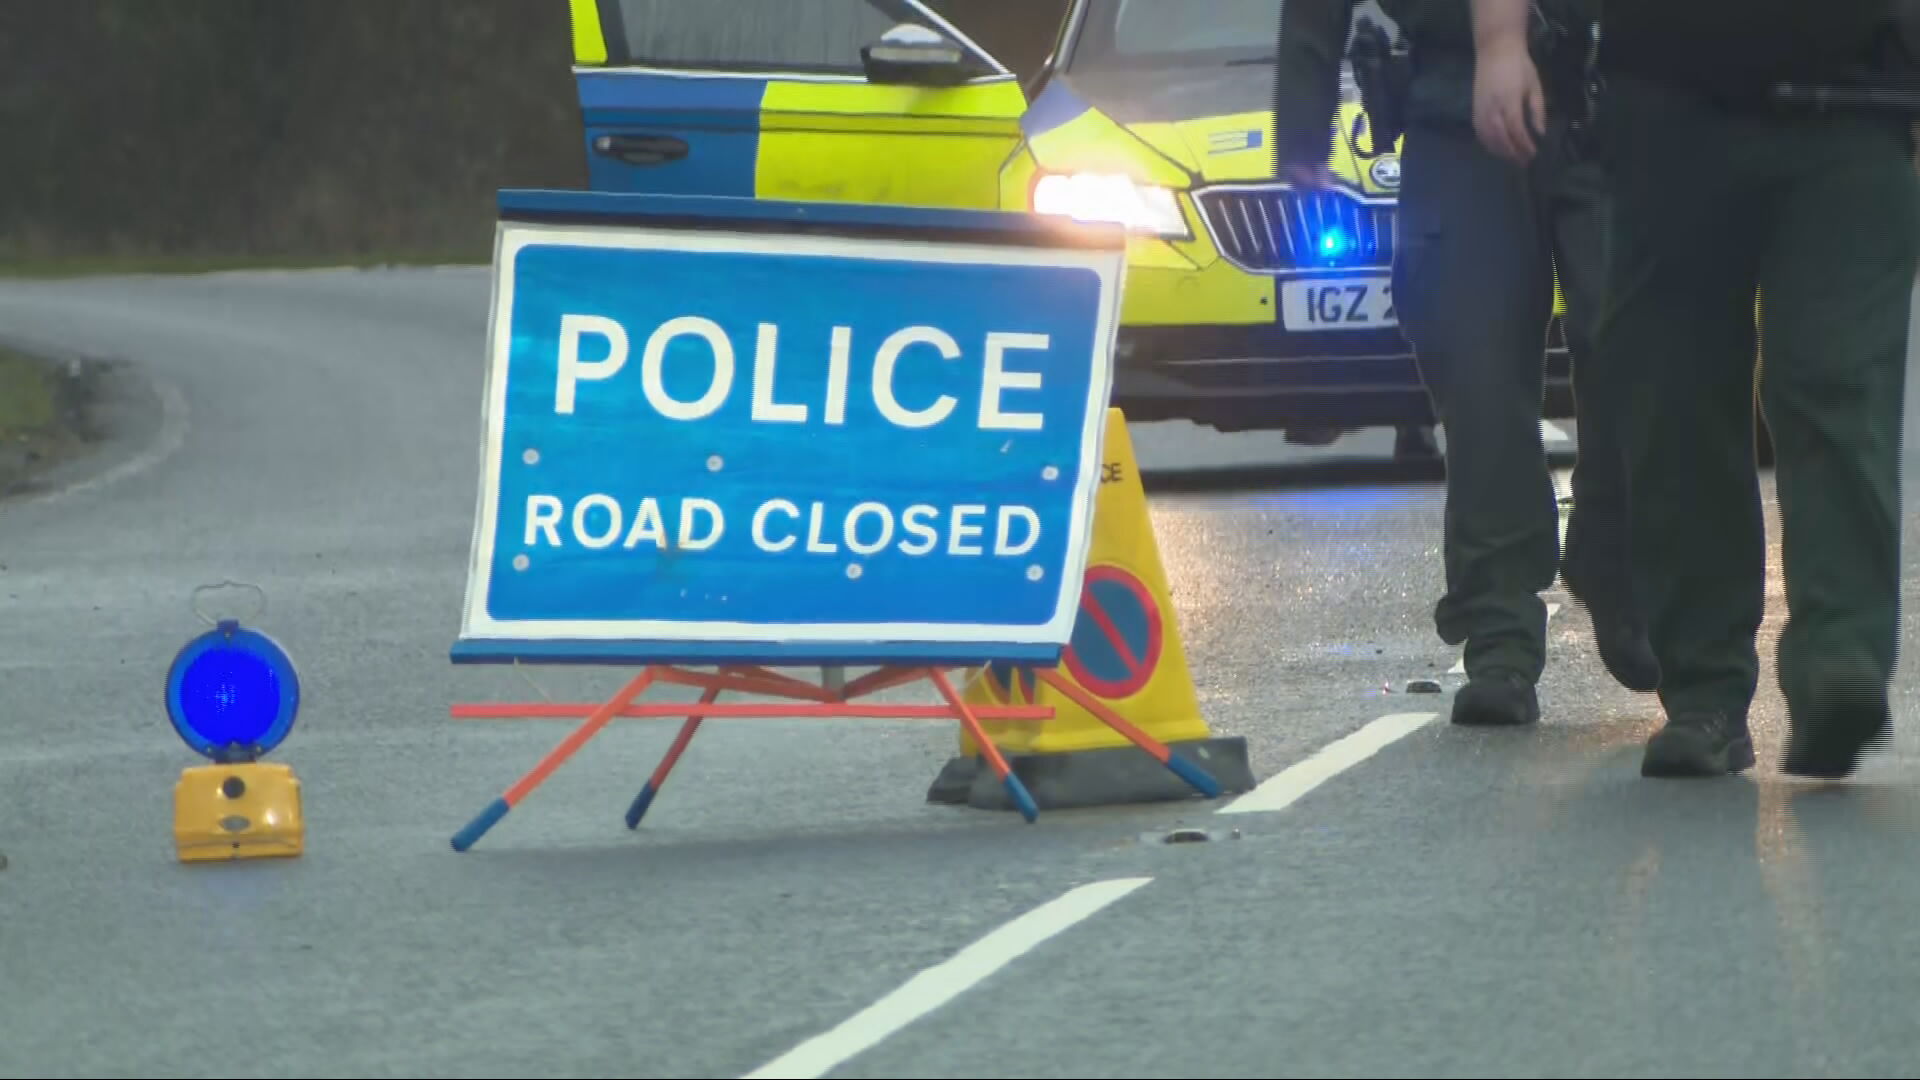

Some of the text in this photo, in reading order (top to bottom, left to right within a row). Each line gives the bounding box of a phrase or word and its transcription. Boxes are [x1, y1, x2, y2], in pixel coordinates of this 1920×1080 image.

[1307, 286, 1368, 323] IGZ
[555, 314, 1050, 430] POLICE
[523, 494, 1041, 556] ROAD CLOSED
